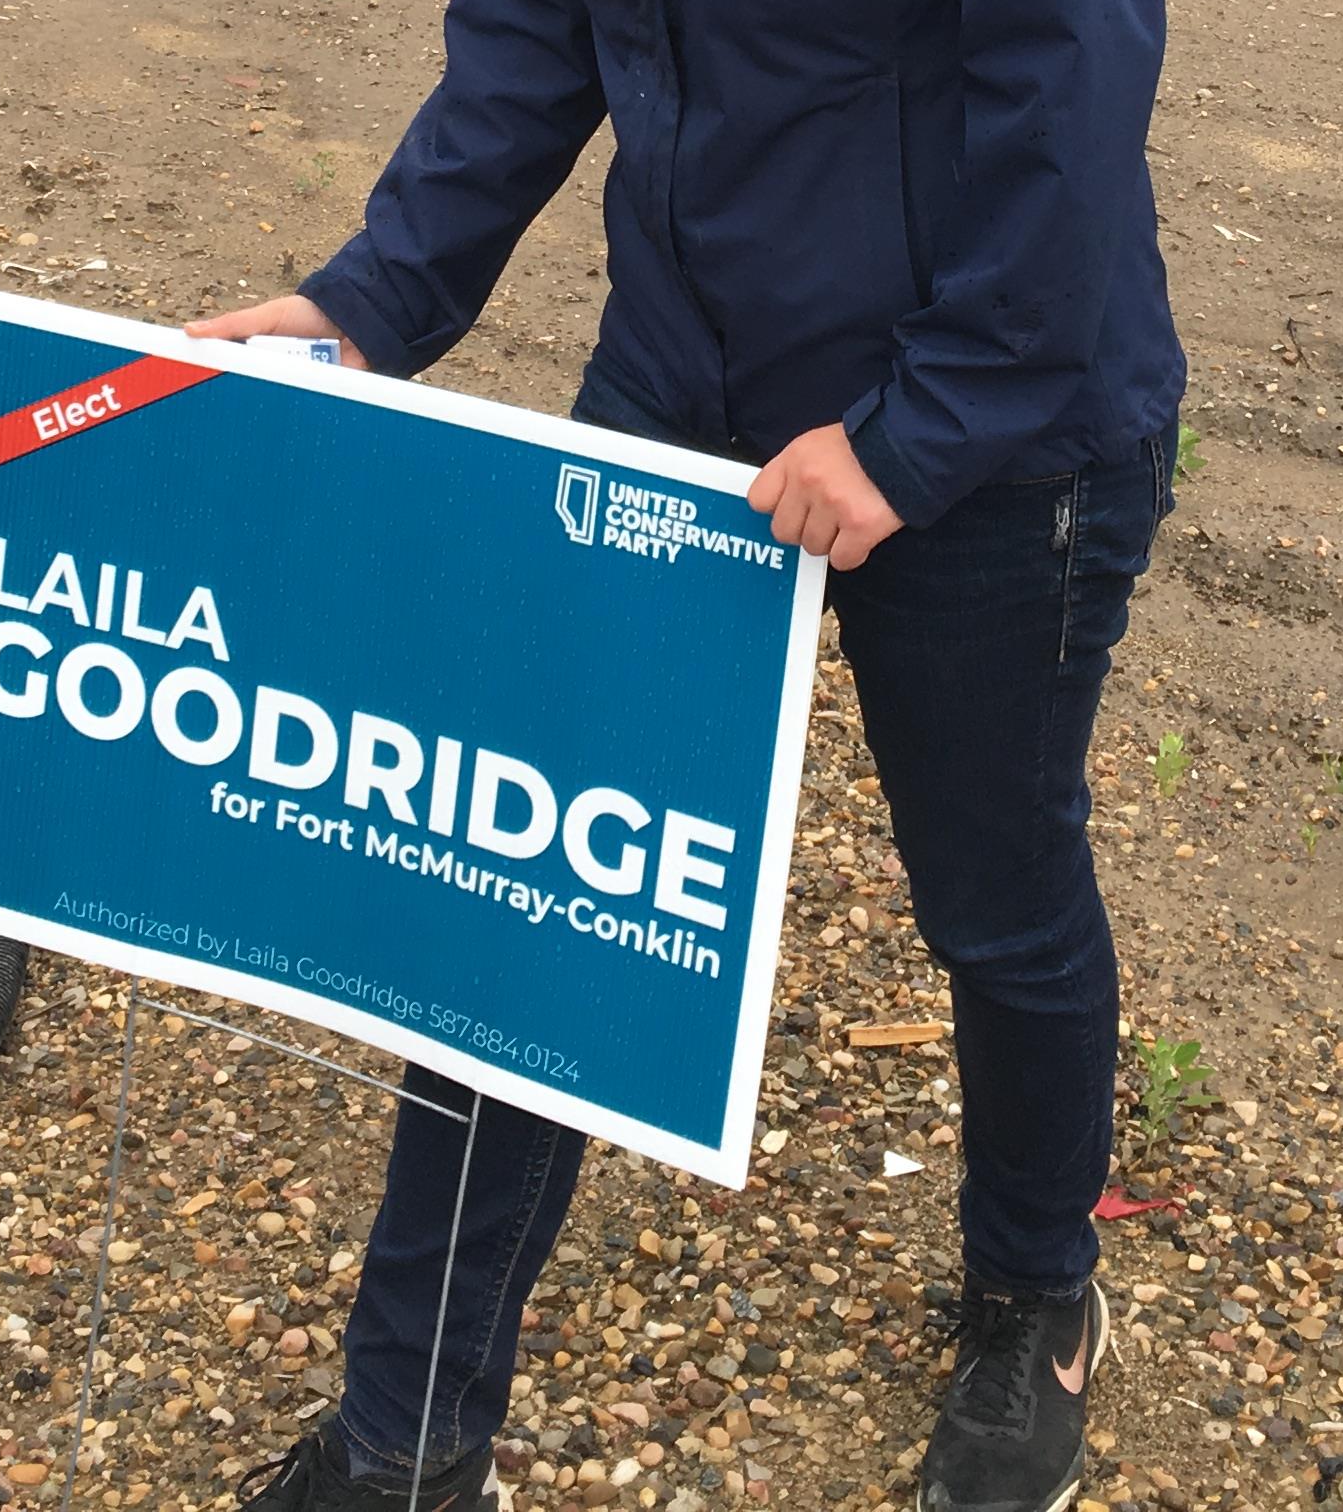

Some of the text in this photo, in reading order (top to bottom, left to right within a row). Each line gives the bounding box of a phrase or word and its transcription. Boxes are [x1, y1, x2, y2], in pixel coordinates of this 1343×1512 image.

[32, 384, 122, 441] Elect
[608, 481, 698, 522] UNITED
[603, 525, 682, 564] PARTY
[605, 504, 785, 570] CONSERVATIVE
[210, 781, 720, 979] for Fort McMurray-Conklin
[53, 890, 581, 1085] Authorized by Laila Goodridge 587.884.0124
